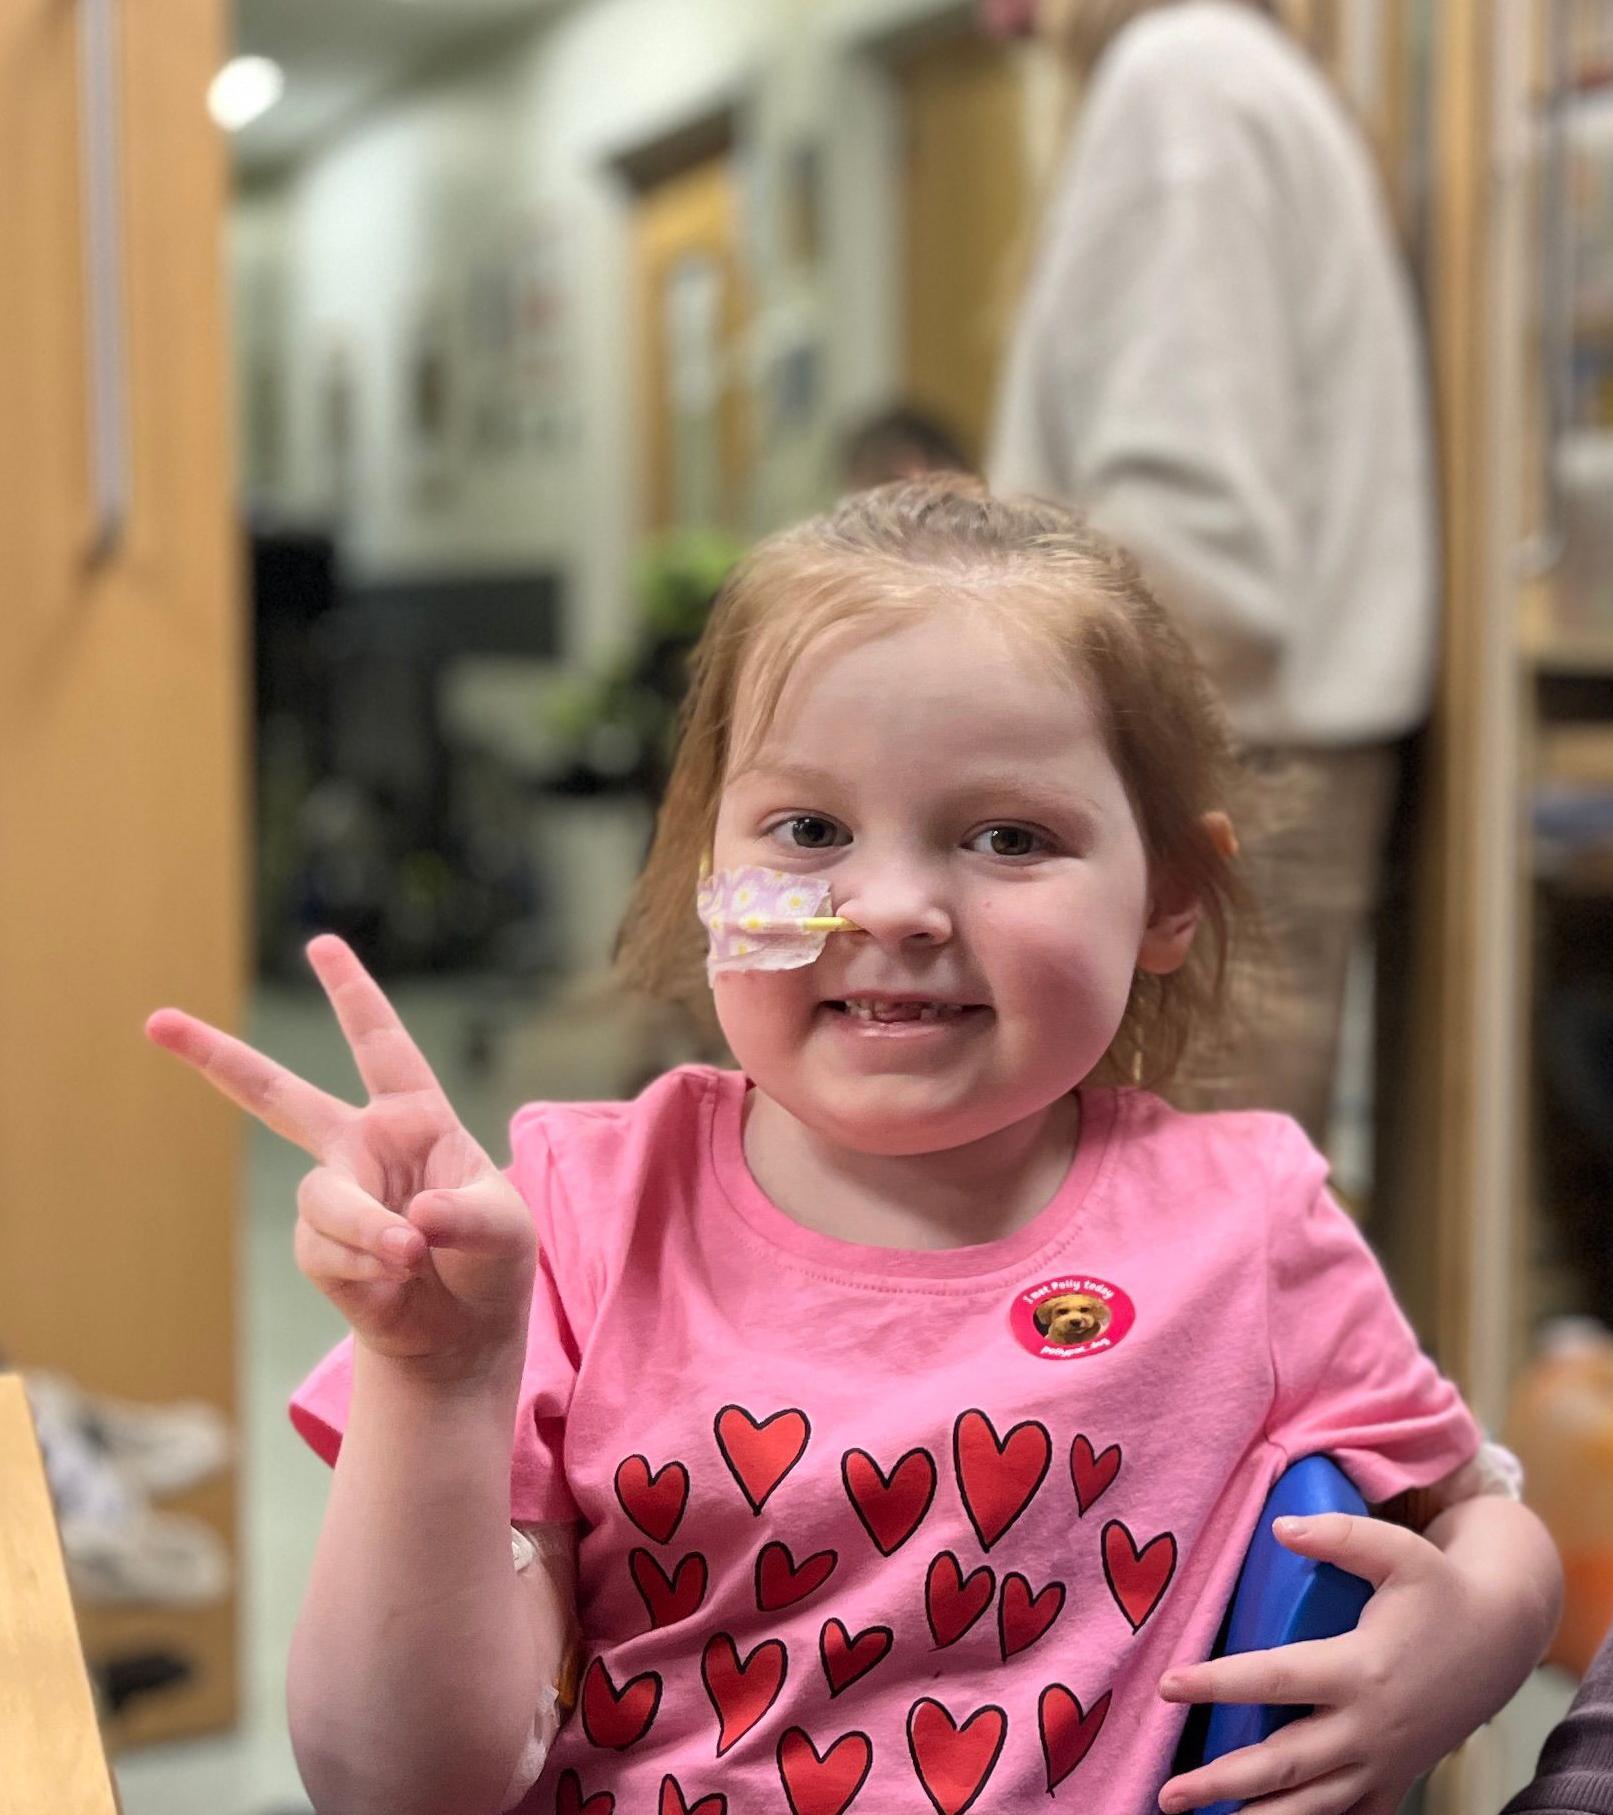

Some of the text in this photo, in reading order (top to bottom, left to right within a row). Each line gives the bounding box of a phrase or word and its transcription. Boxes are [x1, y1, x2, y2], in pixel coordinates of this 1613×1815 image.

[1030, 1286, 1051, 1299] met
[1051, 1280, 1081, 1291] Polly
[1084, 1280, 1115, 1300] today
